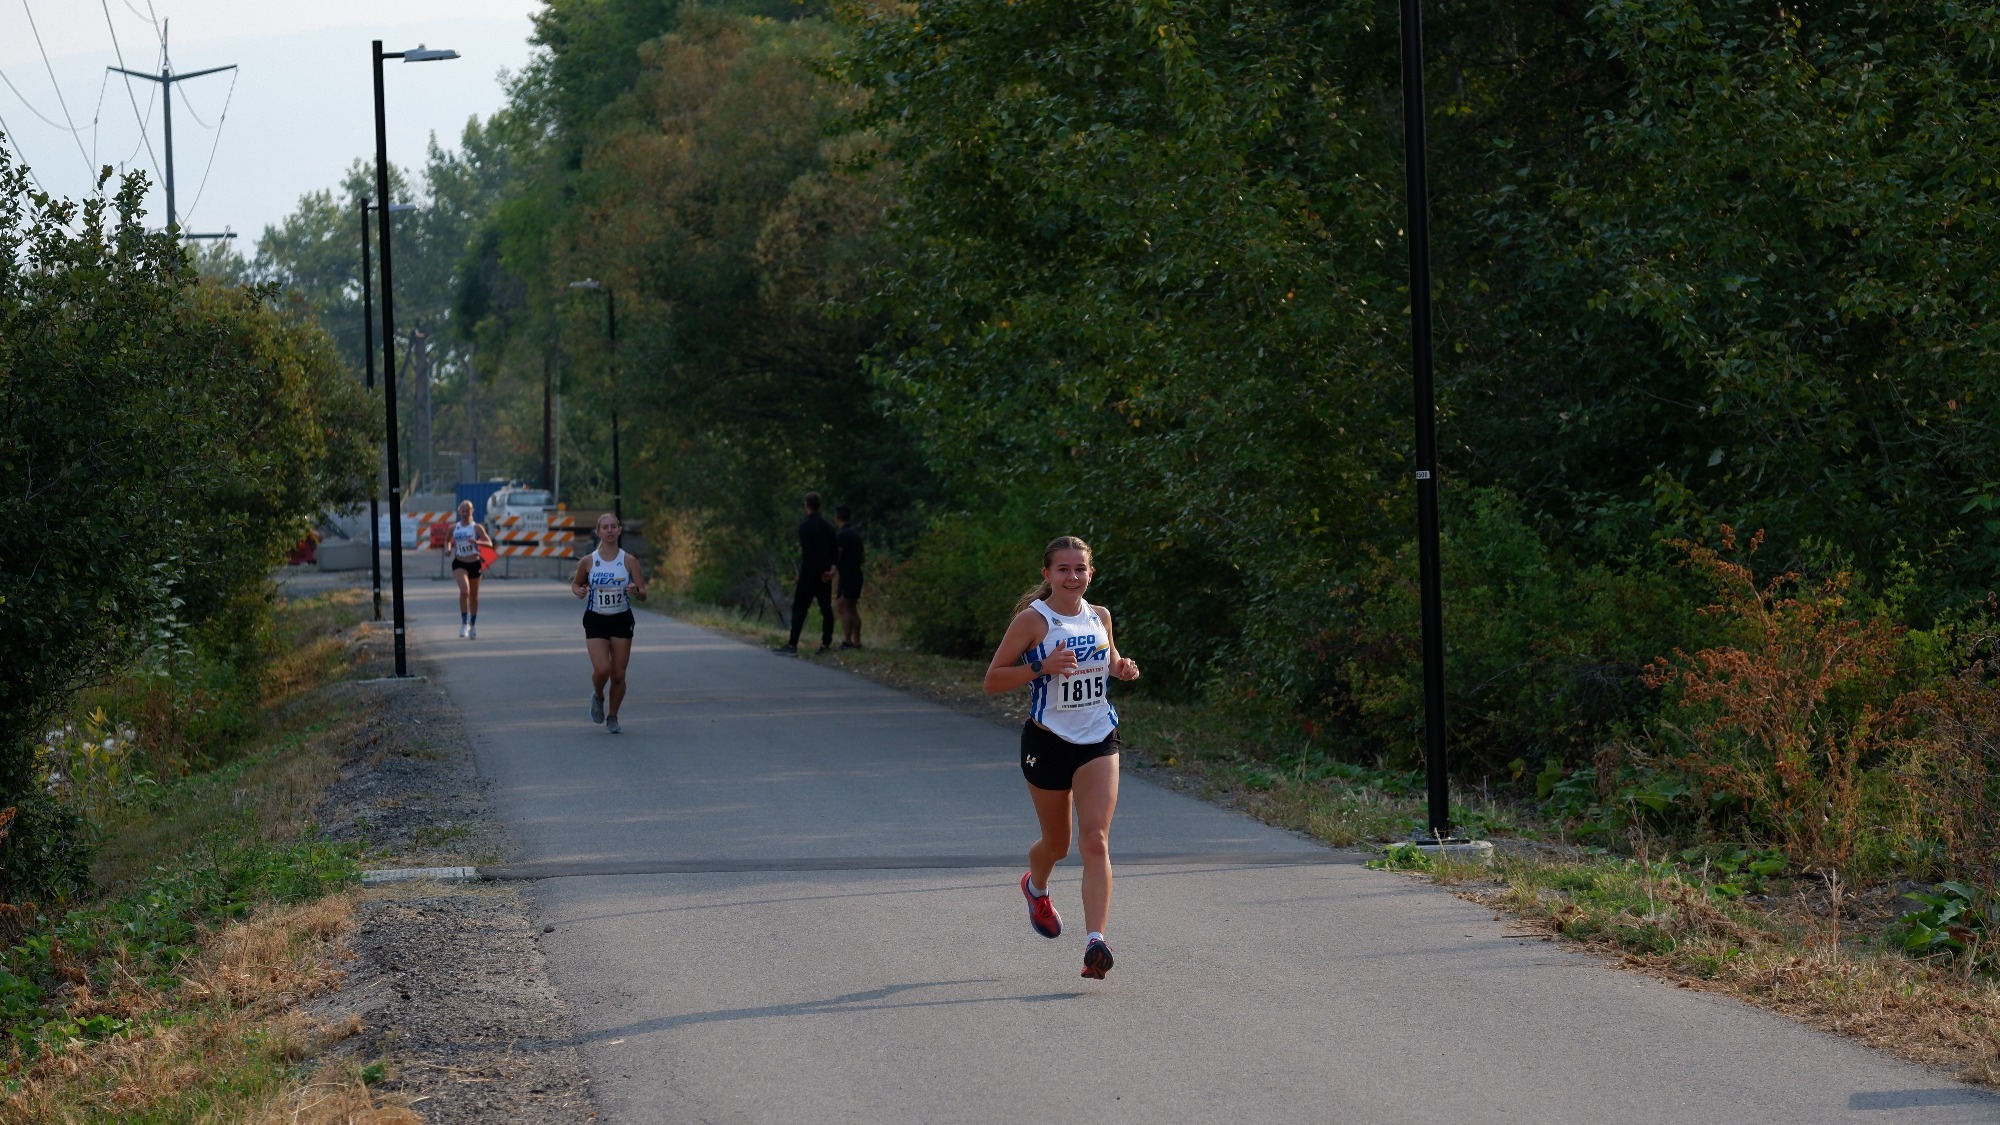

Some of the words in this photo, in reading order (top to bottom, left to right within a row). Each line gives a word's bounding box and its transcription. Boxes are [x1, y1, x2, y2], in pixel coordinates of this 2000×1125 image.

[598, 593, 622, 605] 1812
[1072, 645, 1109, 662] EAT
[1061, 676, 1103, 702] 1815
